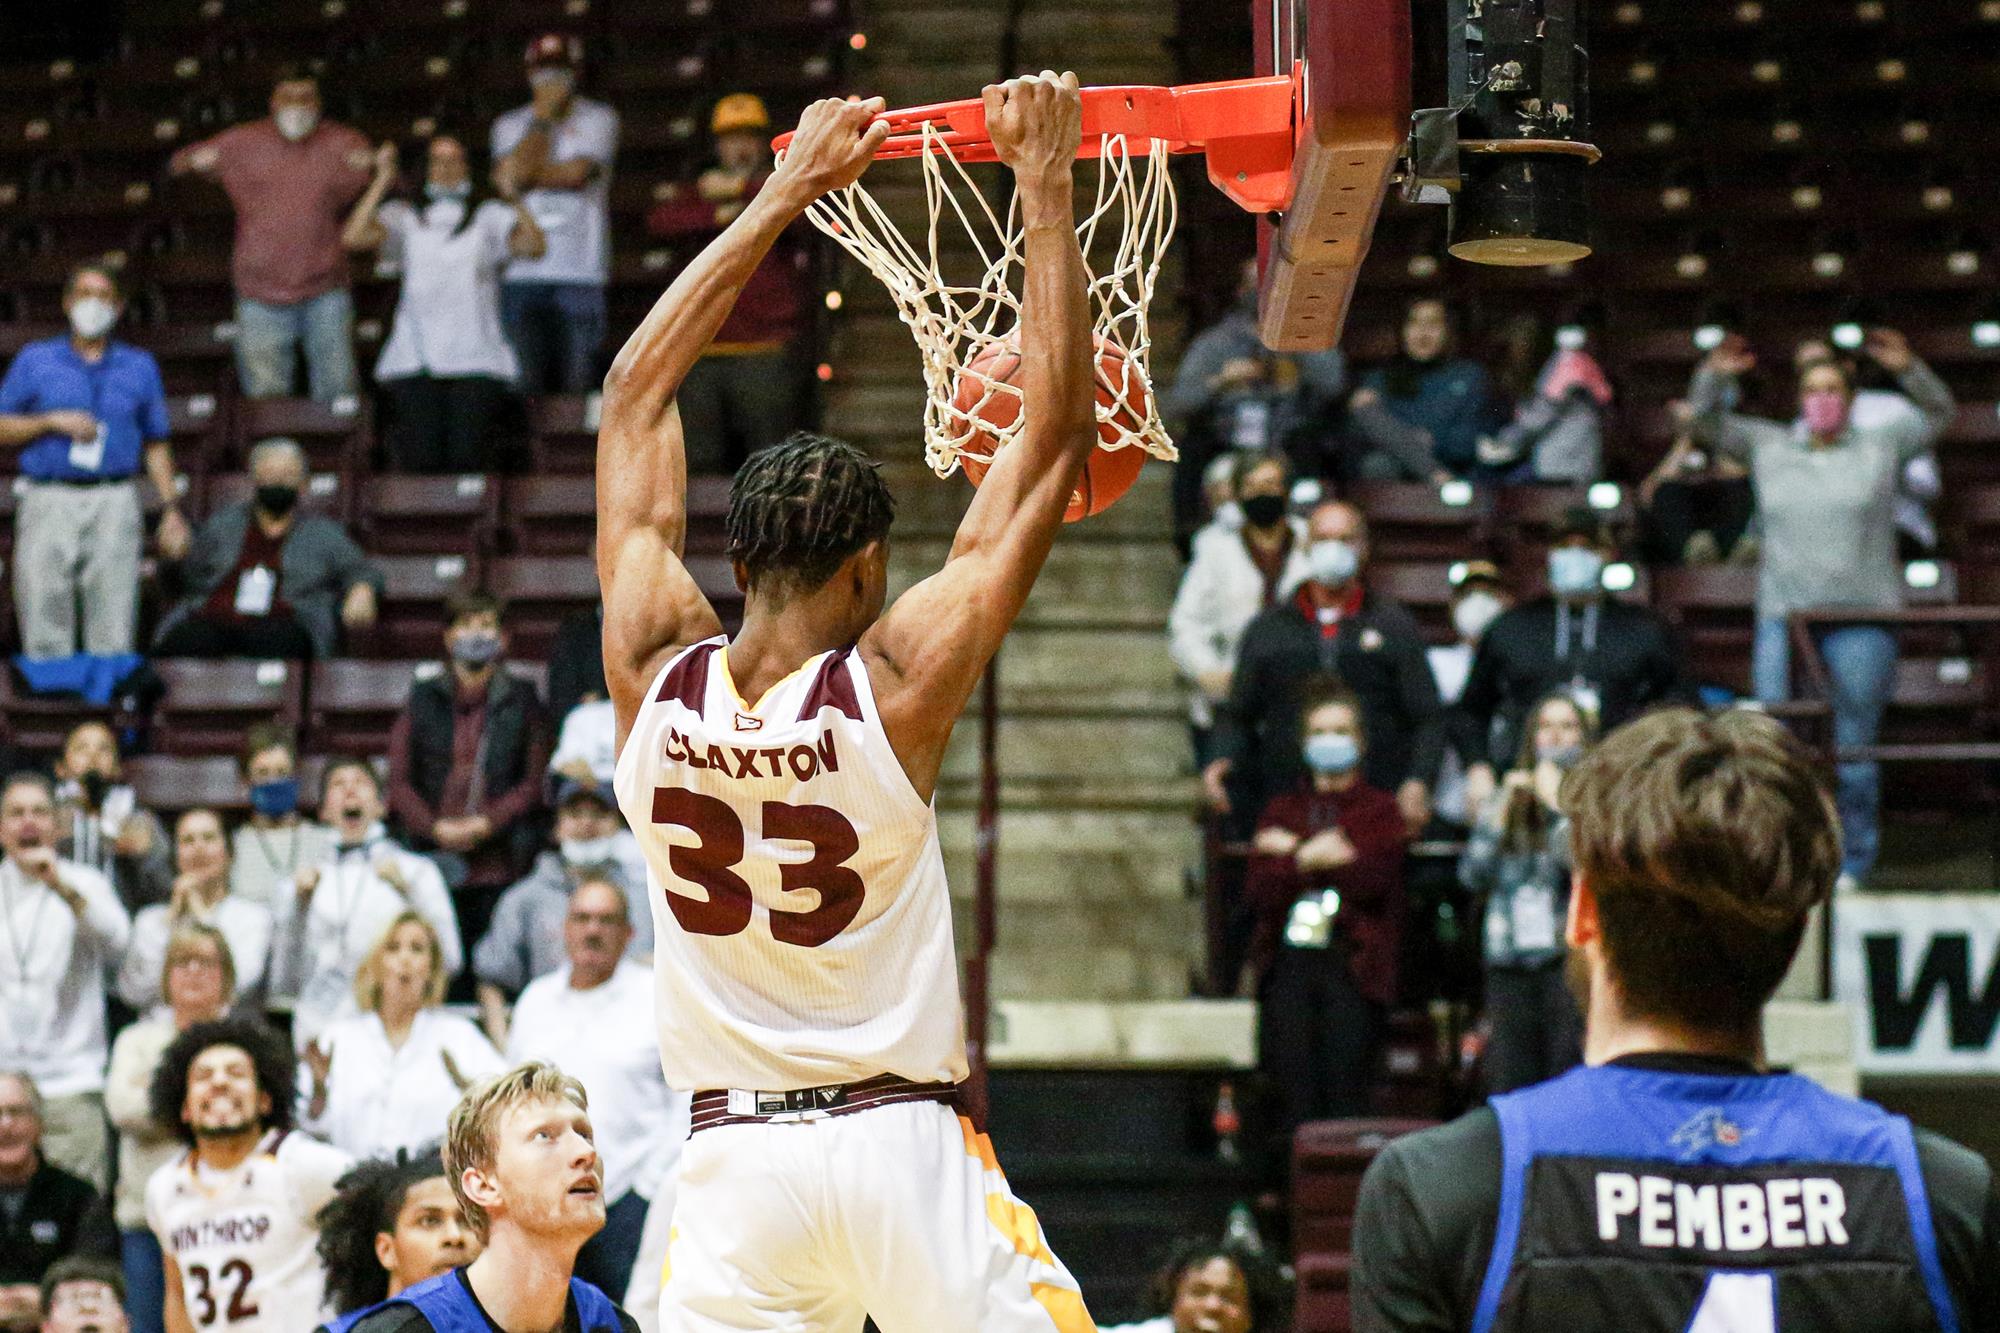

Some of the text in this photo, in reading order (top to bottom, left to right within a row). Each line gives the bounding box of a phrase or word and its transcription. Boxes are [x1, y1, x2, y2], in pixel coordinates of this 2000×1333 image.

[666, 727, 839, 782] CLAXTON
[652, 787, 866, 948] 33
[1863, 932, 2000, 1050] W
[1595, 1172, 1849, 1250] PEMBER
[189, 1259, 259, 1326] 32
